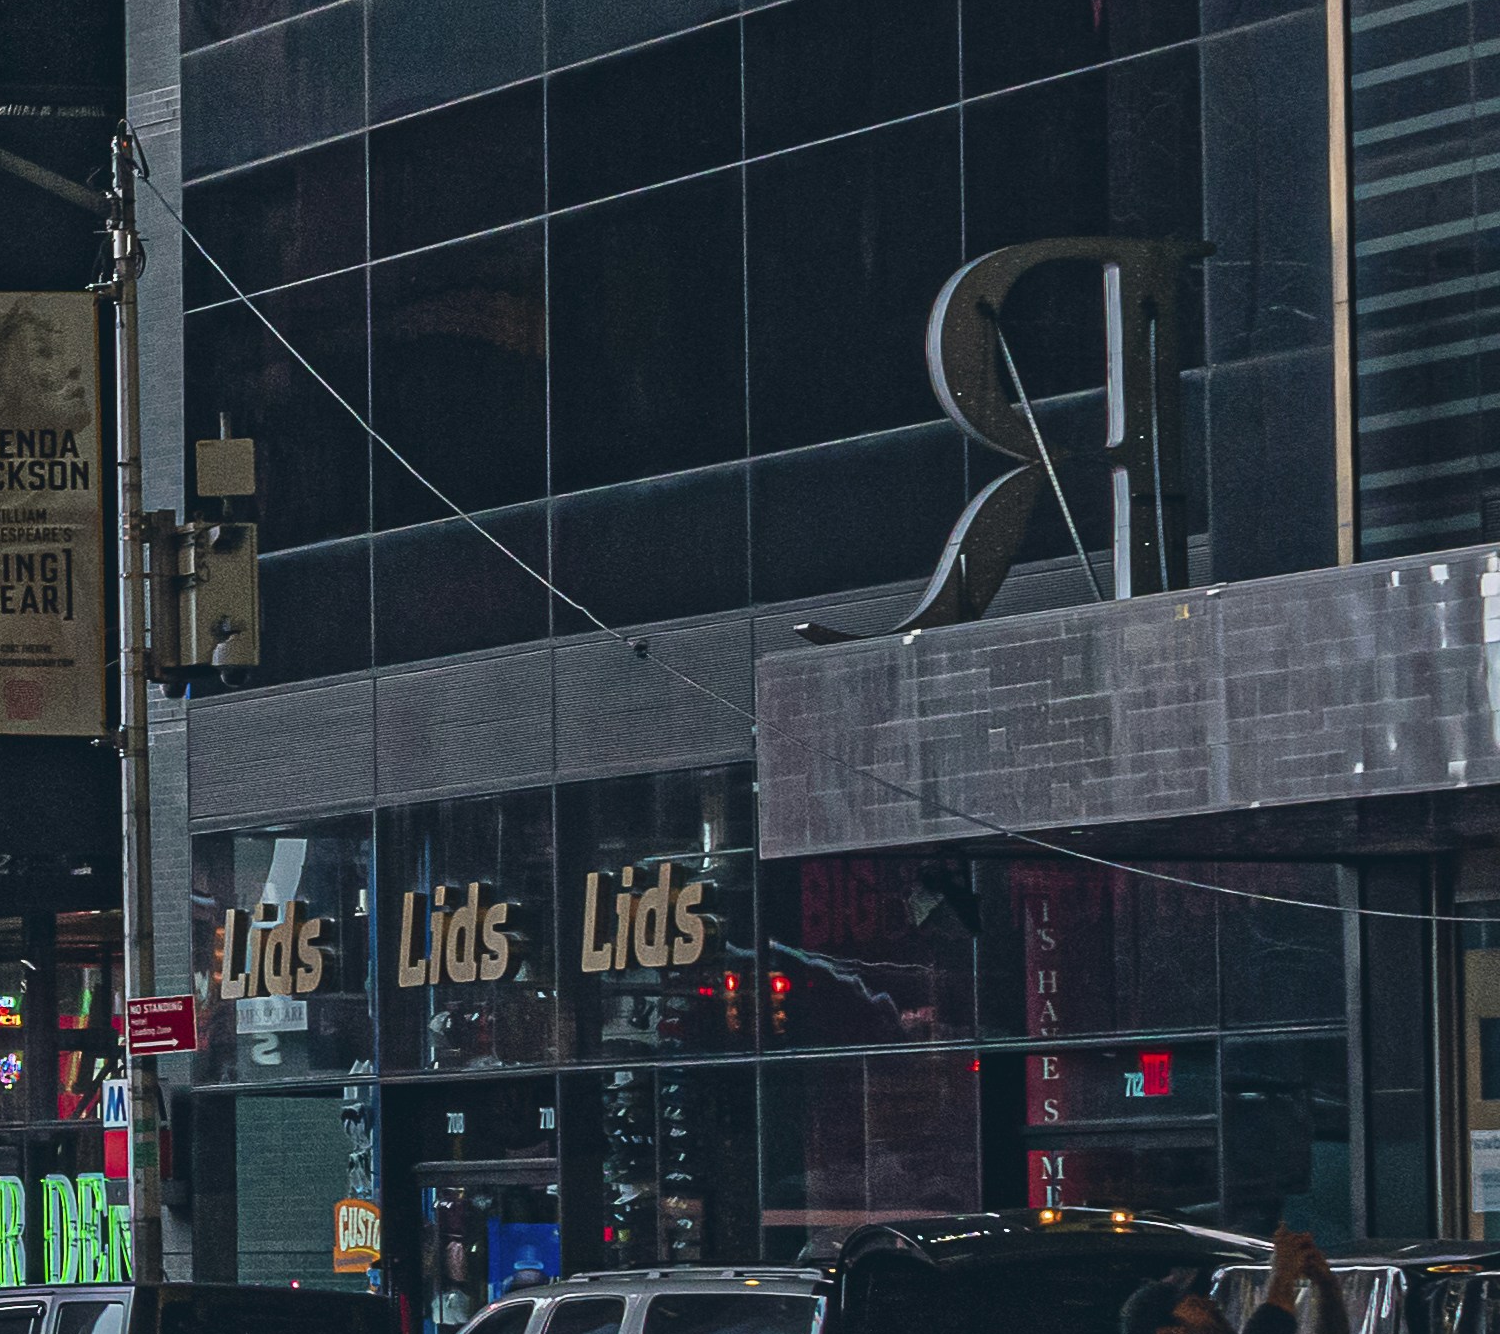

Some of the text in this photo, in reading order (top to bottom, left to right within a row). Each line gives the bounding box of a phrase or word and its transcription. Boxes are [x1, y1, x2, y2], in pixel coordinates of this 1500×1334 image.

[220, 899, 324, 1000] Lids
[400, 881, 509, 988] Lids
[581, 862, 704, 973] Lids
[129, 1001, 183, 1015] NO STANDING
